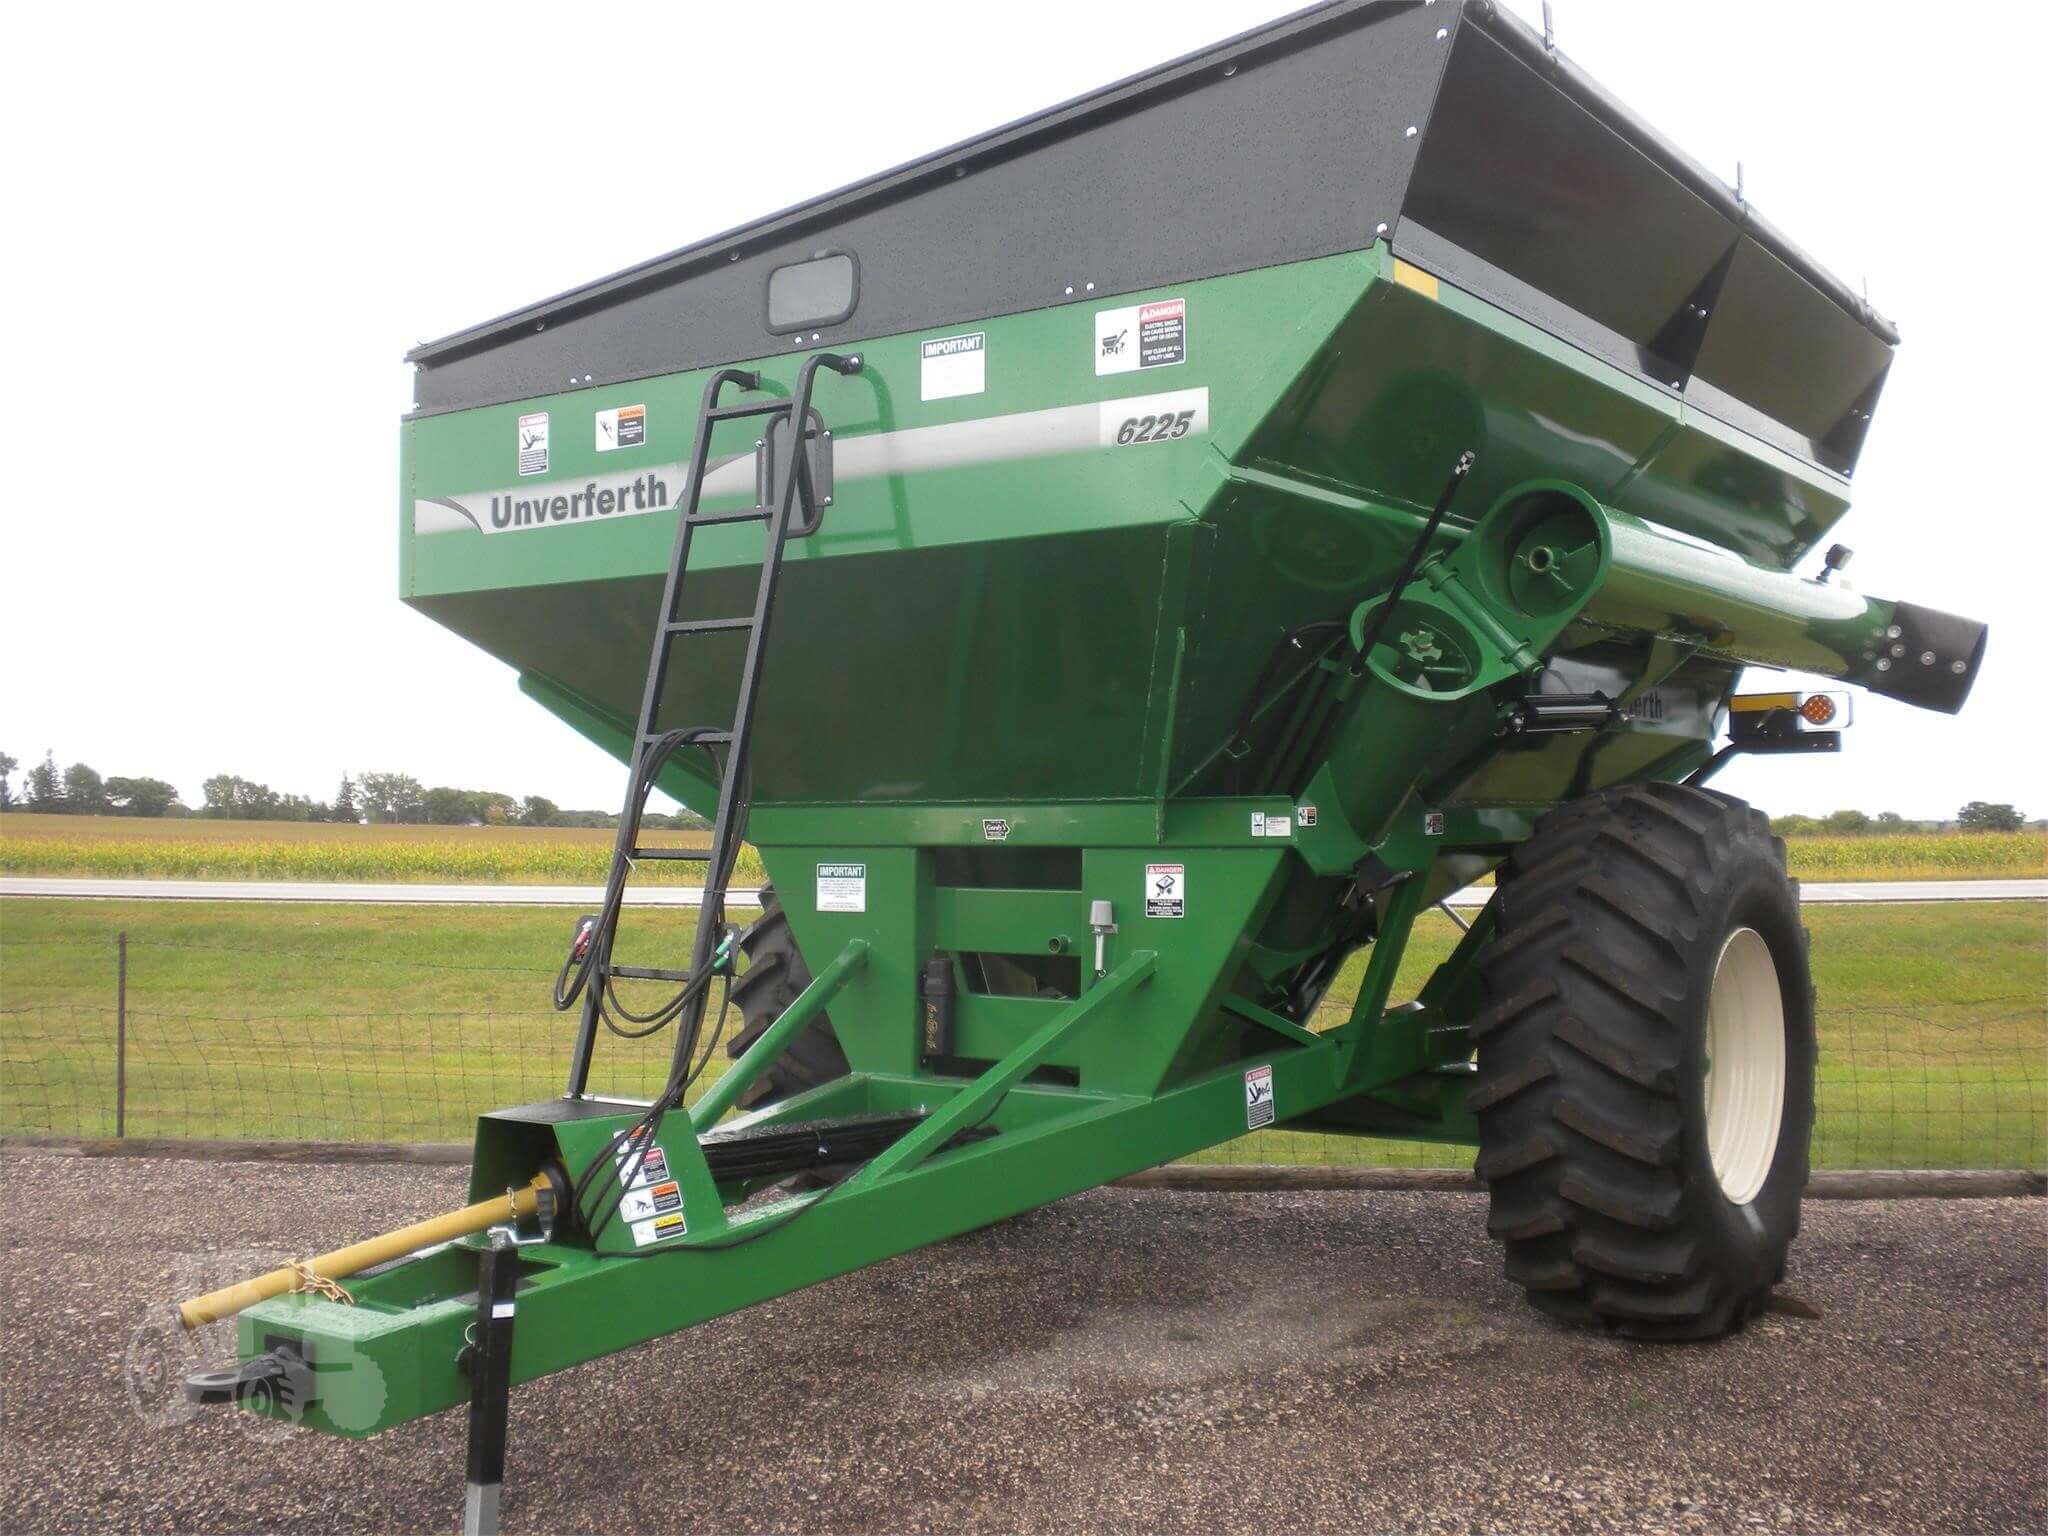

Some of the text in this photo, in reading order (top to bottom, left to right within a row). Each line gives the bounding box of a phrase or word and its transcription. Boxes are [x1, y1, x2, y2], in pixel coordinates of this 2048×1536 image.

[924, 335, 982, 357] IMPORTANT
[1117, 409, 1196, 444] 6225
[490, 472, 667, 529] Unverferth
[819, 866, 863, 877] IMPORTANT
